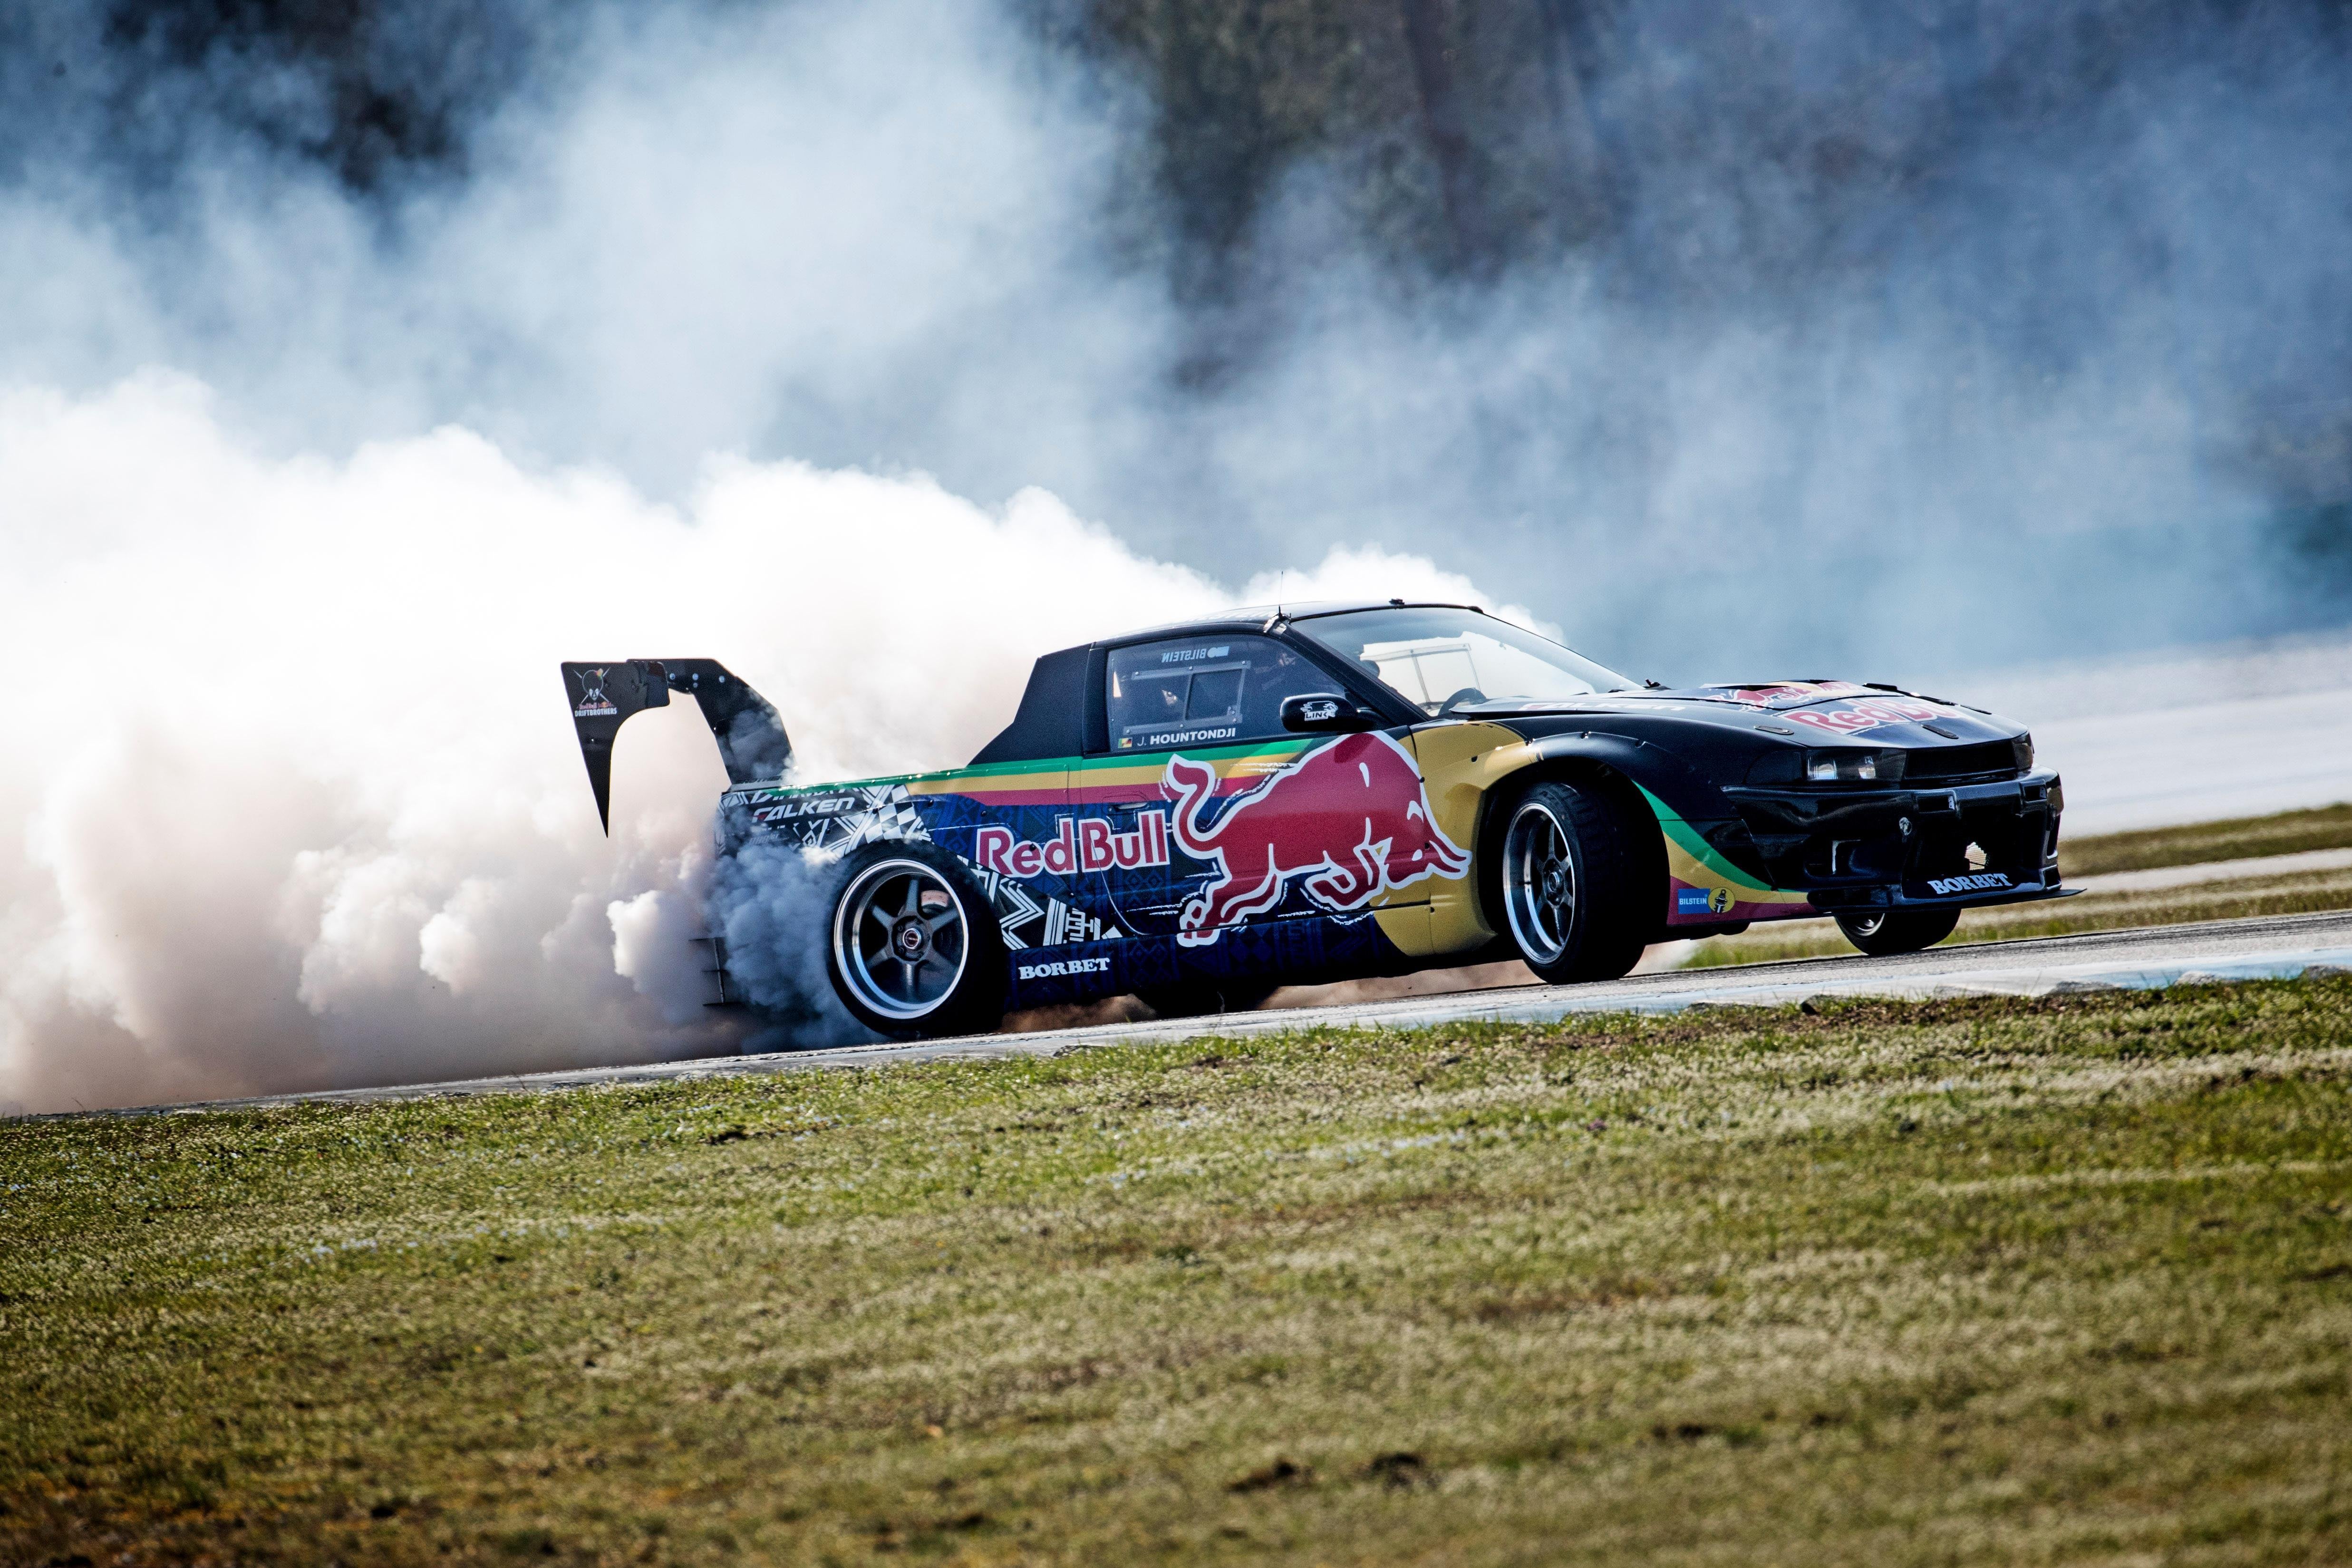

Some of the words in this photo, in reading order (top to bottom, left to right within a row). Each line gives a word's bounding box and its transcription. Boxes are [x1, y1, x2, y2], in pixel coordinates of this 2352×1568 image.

[574, 707, 617, 717] DRIFTBROTHERS
[1137, 736, 1147, 746] J.
[1150, 727, 1236, 745] HOUNTONDJI
[752, 797, 855, 823] FALKEN
[976, 817, 1077, 878] Red
[1078, 809, 1170, 872] Bull
[1927, 873, 2013, 894] BORBET
[1679, 897, 1707, 905] BILSTEIN
[1018, 958, 1110, 979] BORBET
